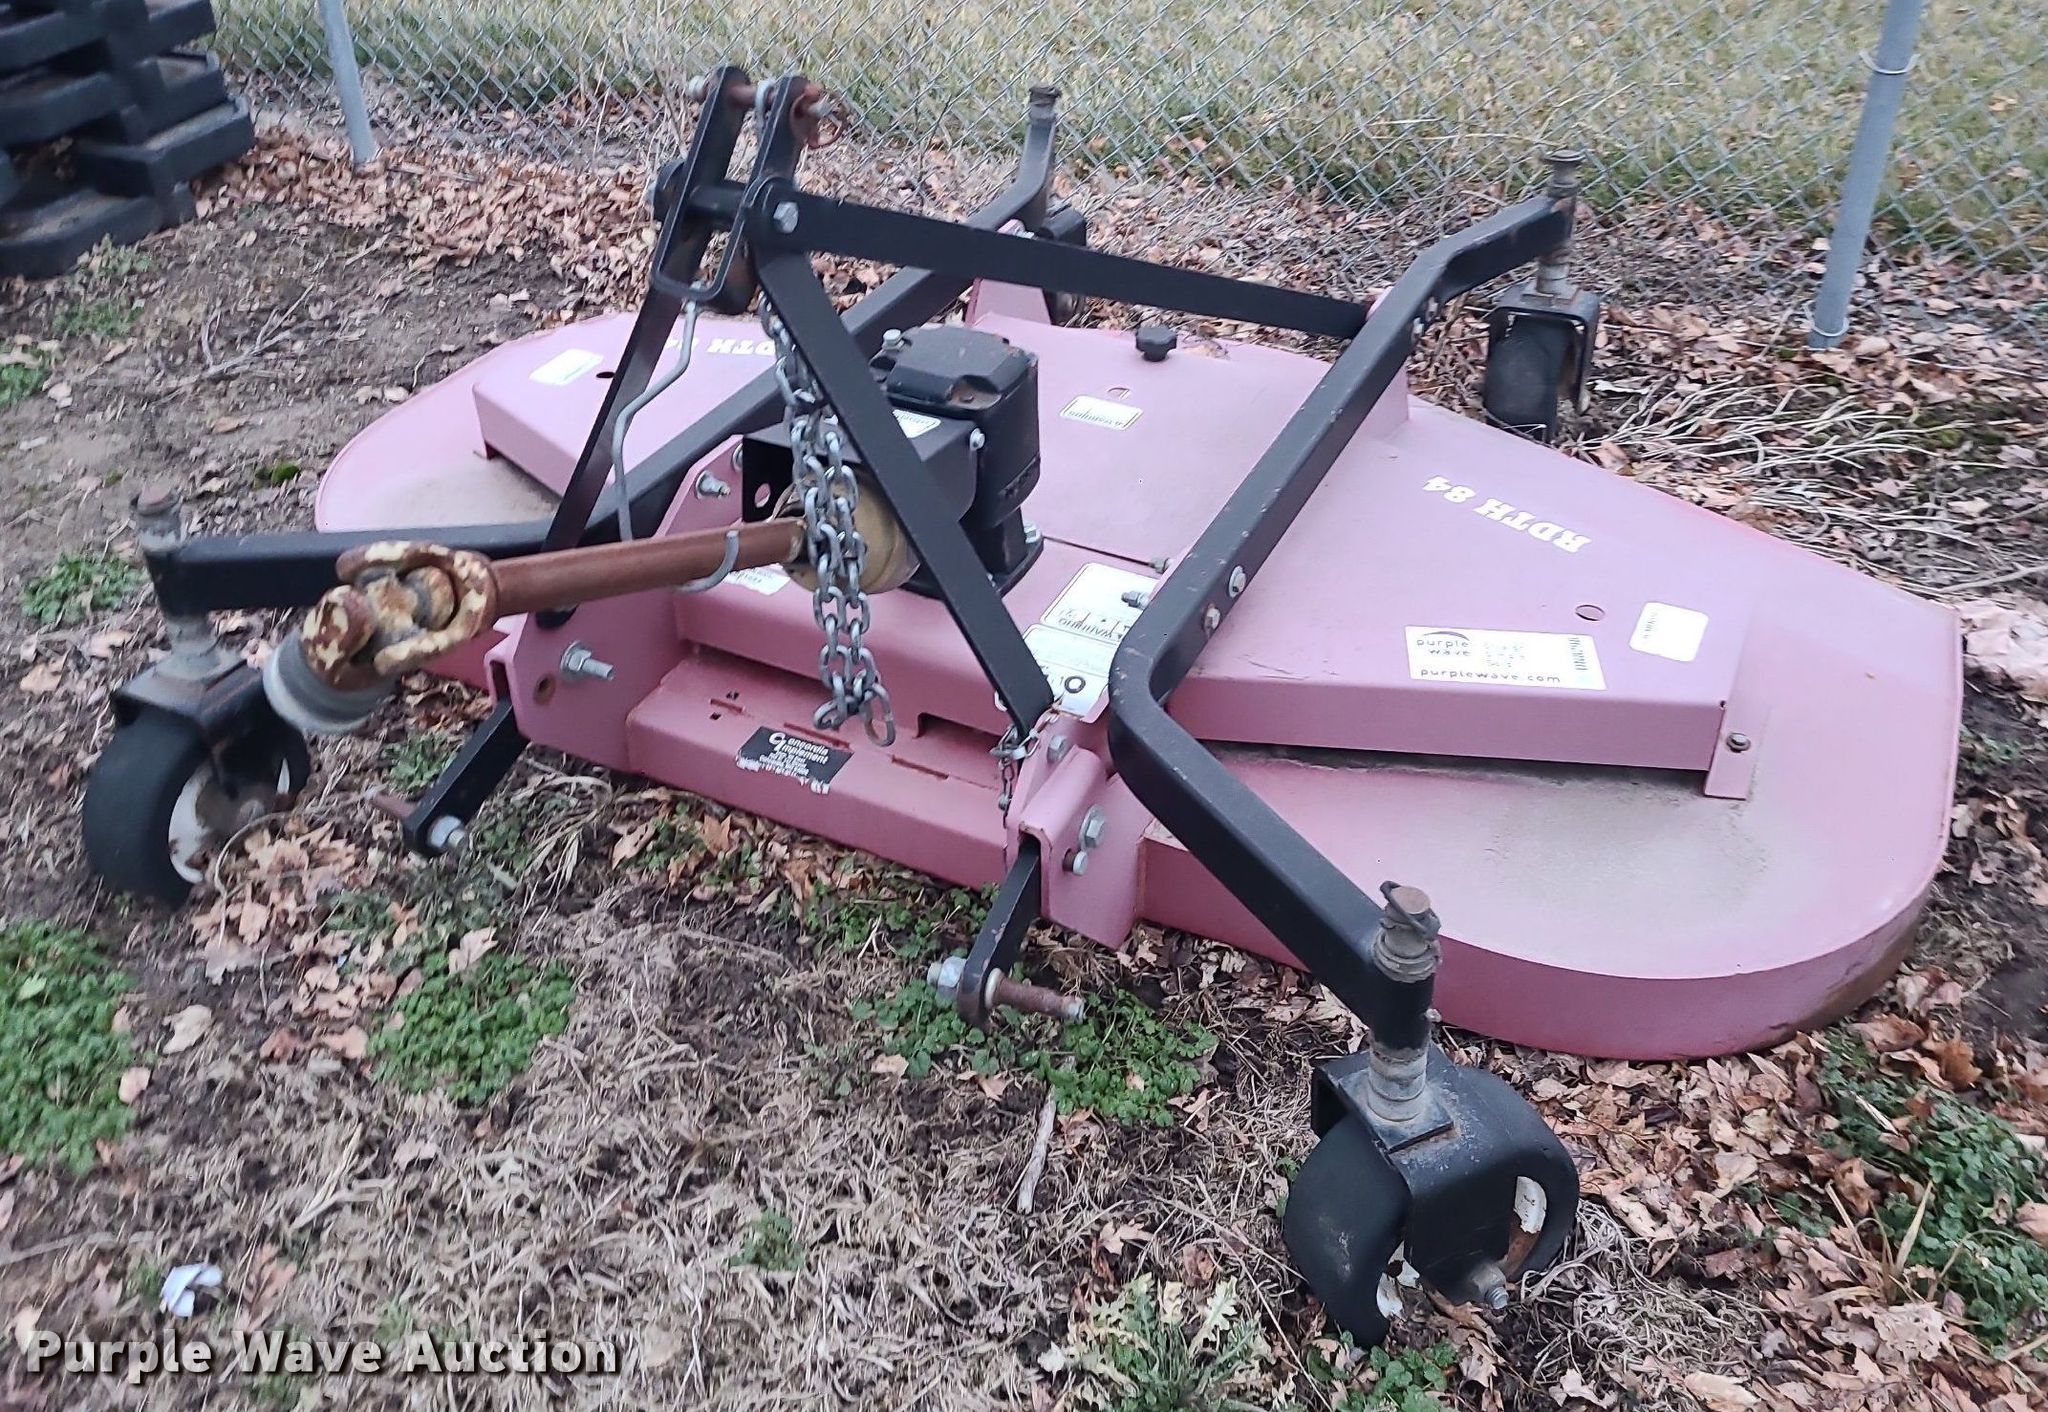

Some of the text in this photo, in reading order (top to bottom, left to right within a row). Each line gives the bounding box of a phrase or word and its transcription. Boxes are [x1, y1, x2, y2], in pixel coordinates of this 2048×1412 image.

[1422, 475, 1592, 553] RDTH 84
[1416, 637, 1470, 649] purple
[1428, 649, 1470, 658] wave
[1420, 669, 1561, 683] purplewavecom
